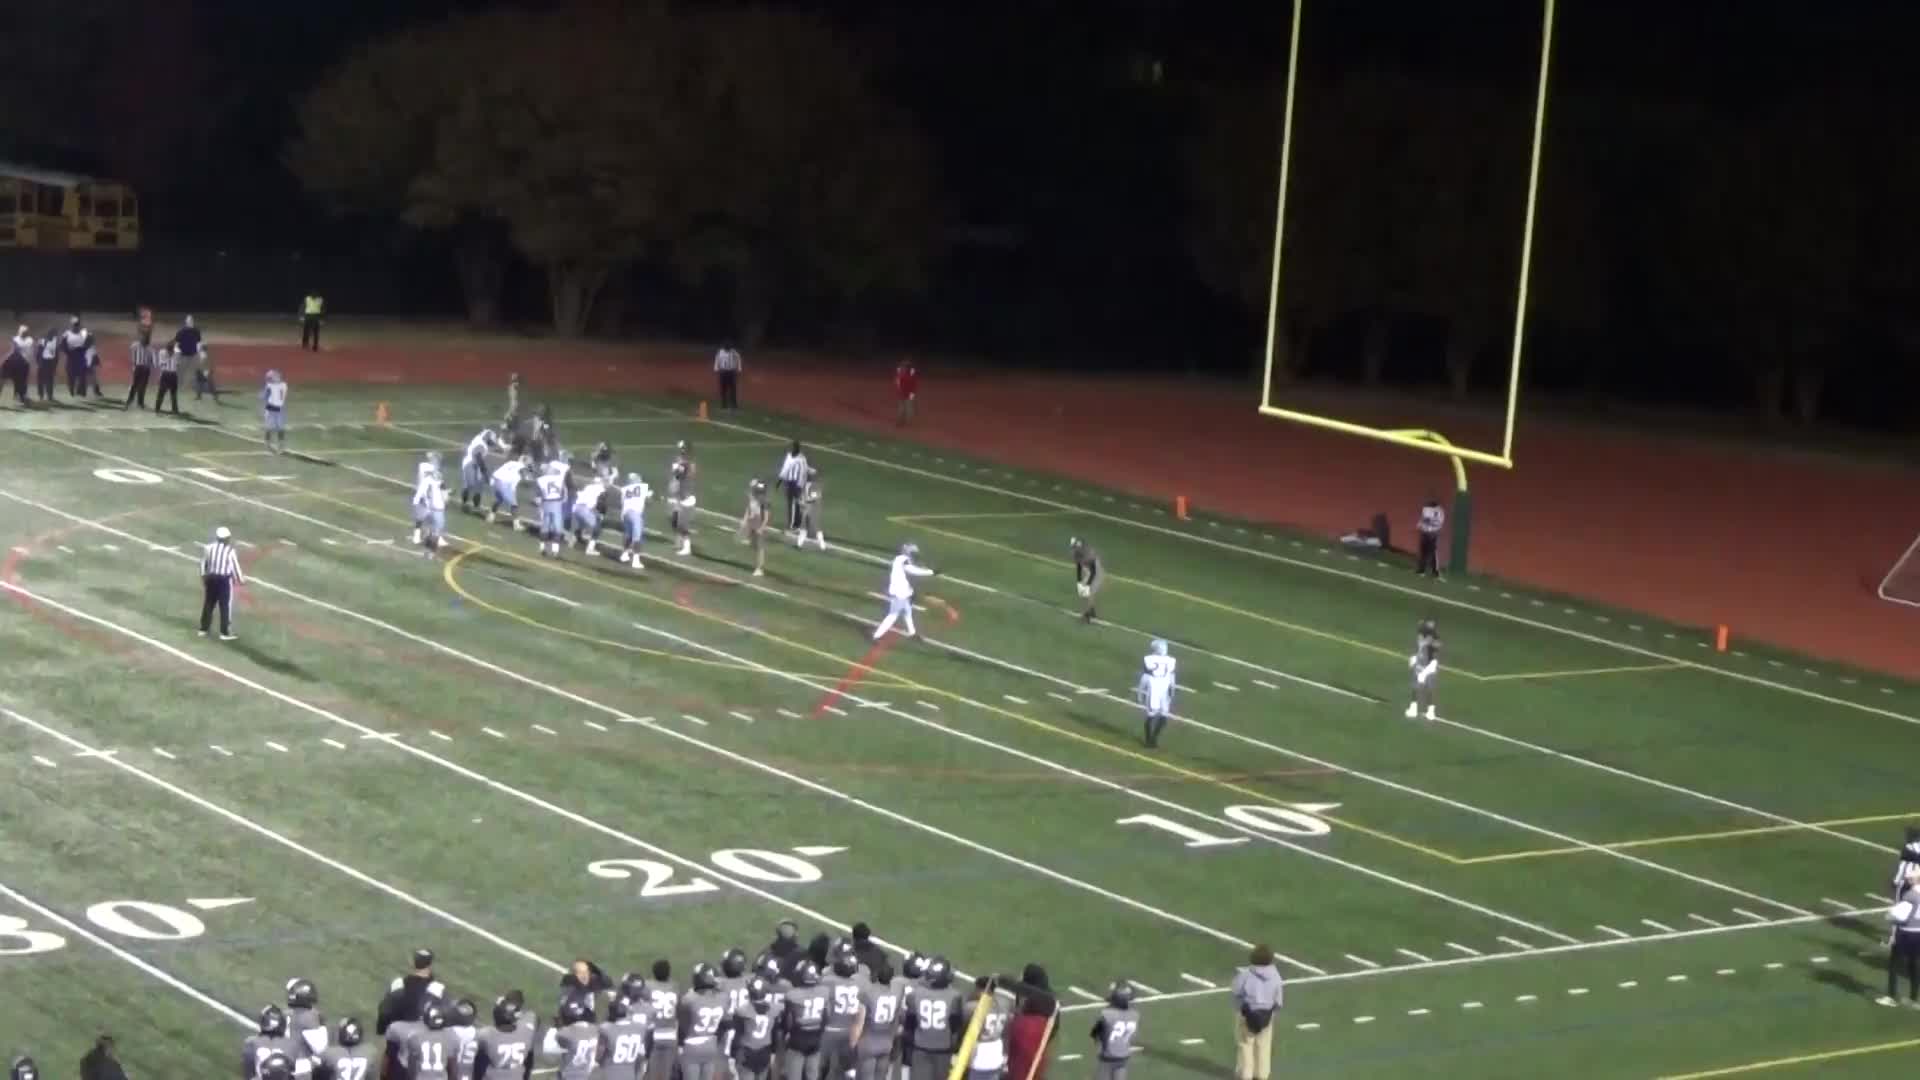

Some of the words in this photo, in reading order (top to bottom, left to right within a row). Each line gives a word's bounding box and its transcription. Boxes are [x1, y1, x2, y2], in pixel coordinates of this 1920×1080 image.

[587, 848, 824, 898] 20
[919, 999, 947, 1030] 92
[421, 1041, 444, 1071] 11
[497, 1041, 526, 1069] 75
